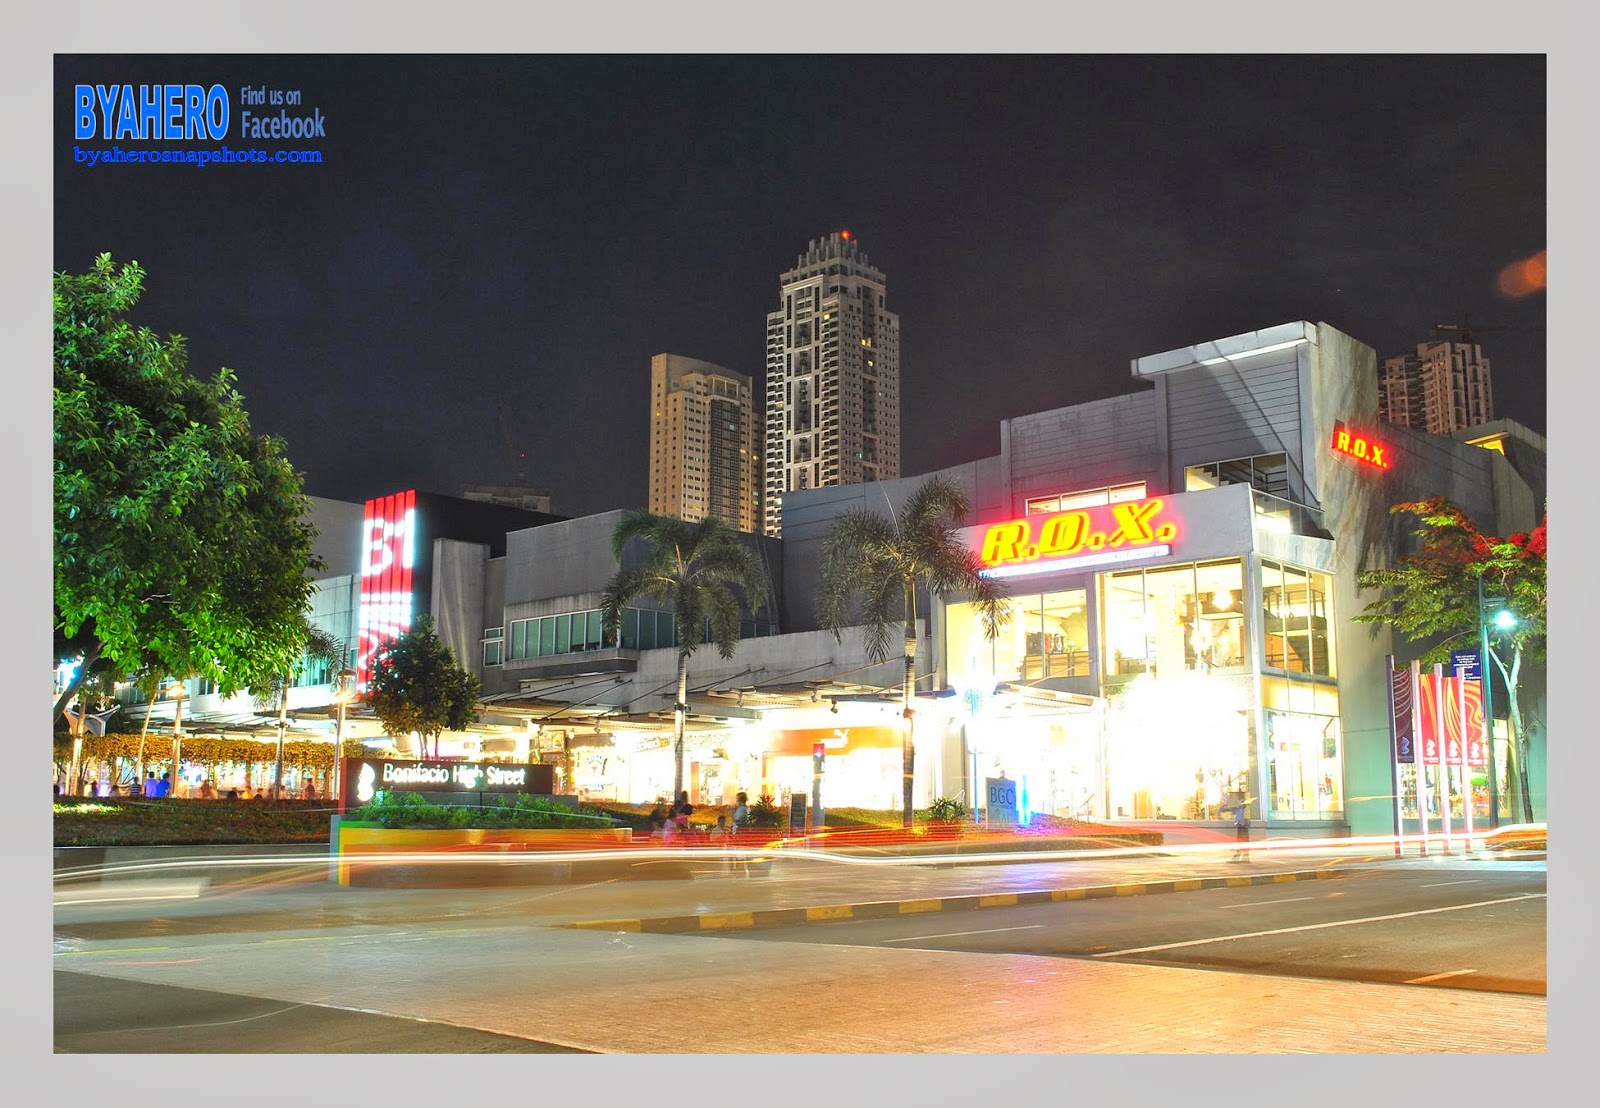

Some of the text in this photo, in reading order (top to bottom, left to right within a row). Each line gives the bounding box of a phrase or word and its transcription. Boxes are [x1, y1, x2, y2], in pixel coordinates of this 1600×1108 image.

[1337, 430, 1388, 468] R.O.X.
[361, 508, 416, 577] B1
[980, 500, 1176, 564] R.O.X.
[382, 761, 526, 789] Bonifacio High Street
[989, 786, 1015, 805] BGC
